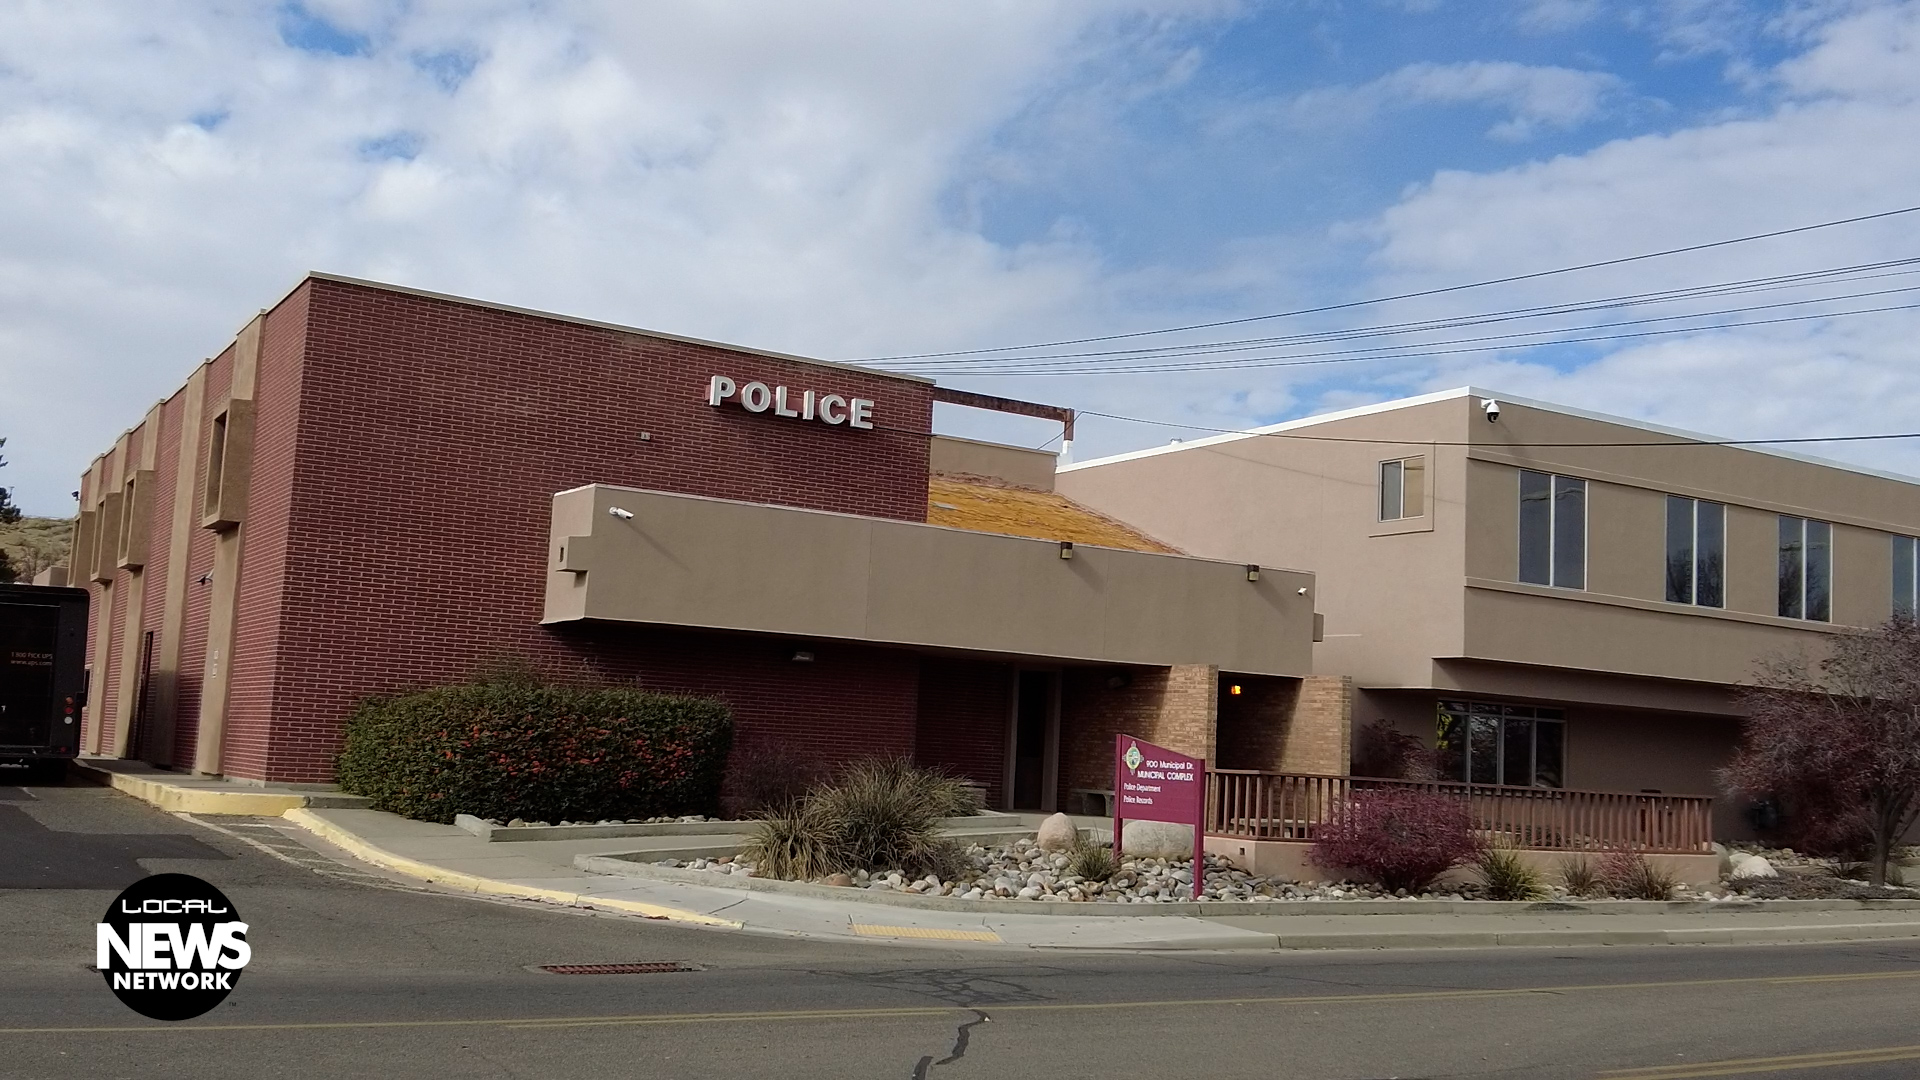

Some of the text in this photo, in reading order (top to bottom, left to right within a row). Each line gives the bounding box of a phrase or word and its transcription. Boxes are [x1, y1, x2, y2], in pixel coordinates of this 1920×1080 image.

[709, 375, 875, 429] POLICE
[1146, 760, 1158, 768] 900
[1160, 760, 1185, 770] Municipal
[1137, 770, 1194, 781] MUNICIPAL COMPLEX
[1123, 782, 1161, 793] Police Department
[1123, 795, 1153, 805] Police Records
